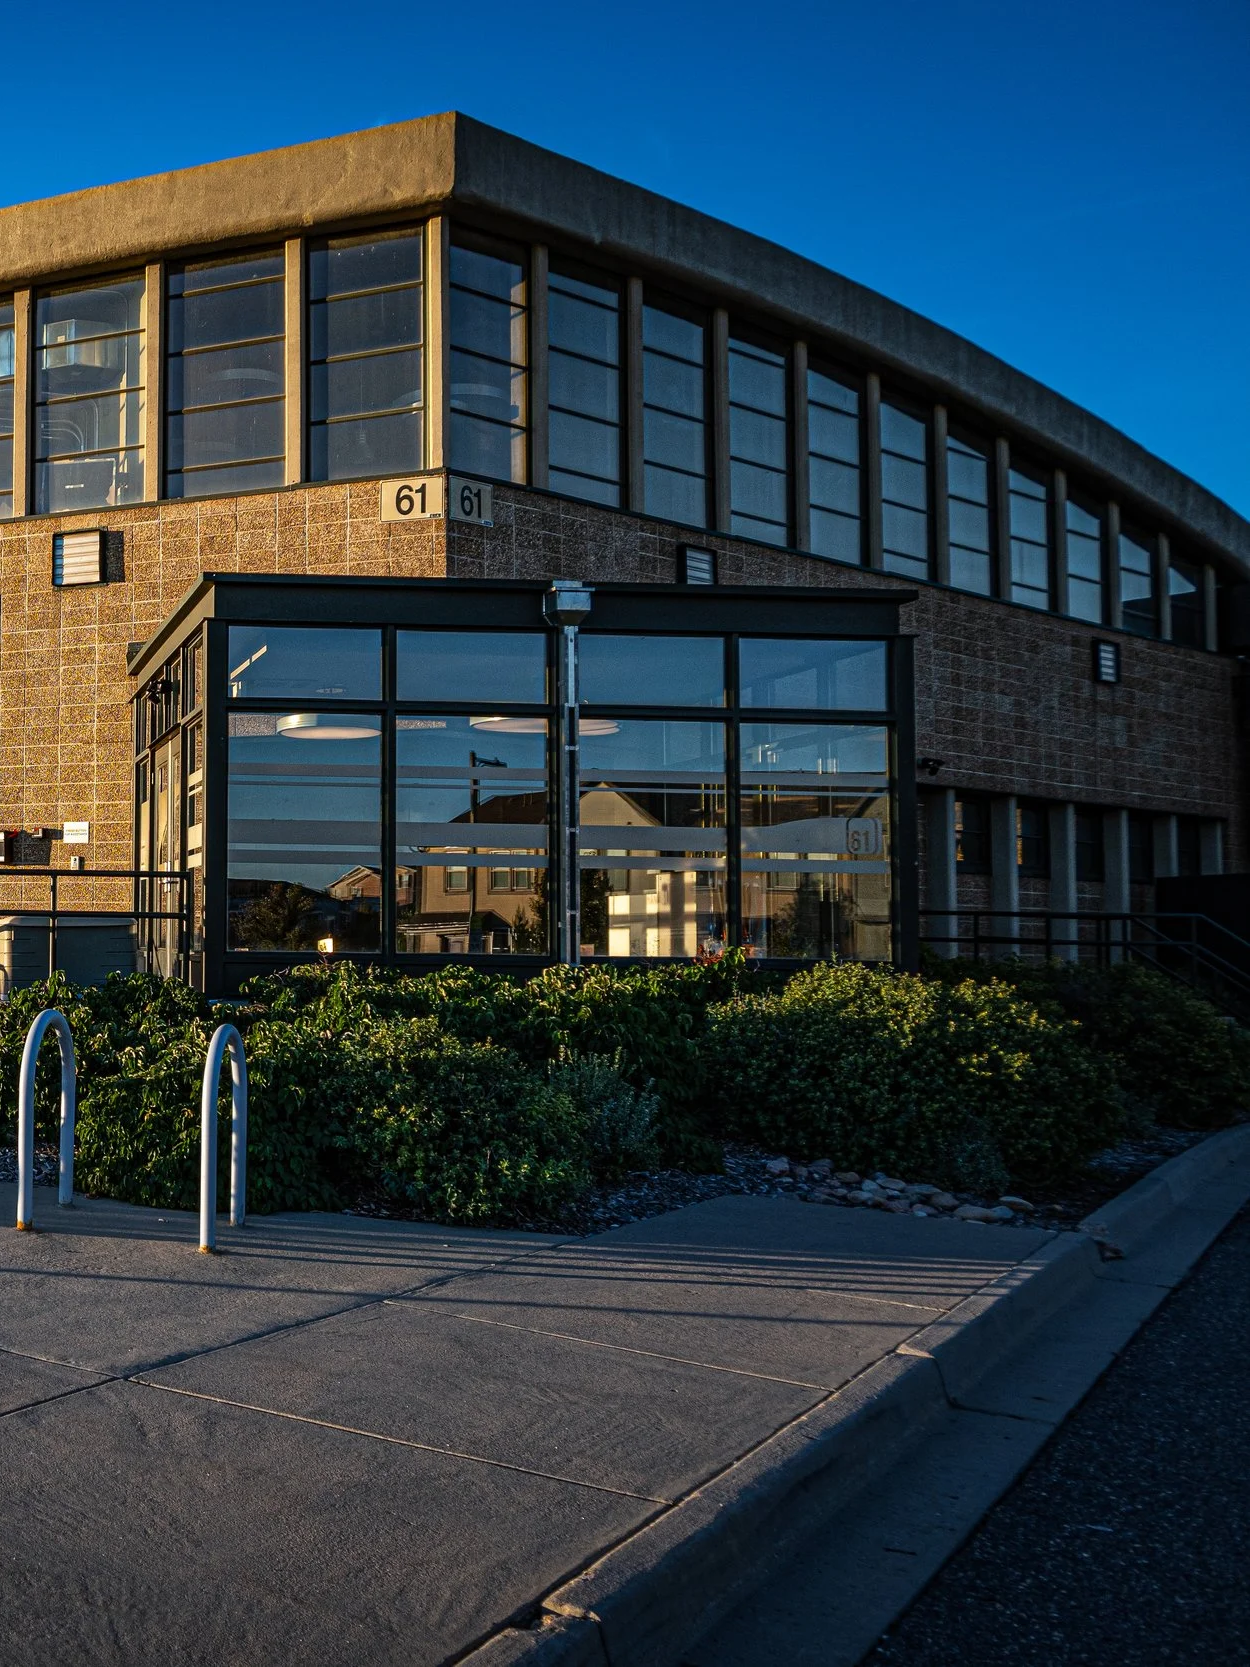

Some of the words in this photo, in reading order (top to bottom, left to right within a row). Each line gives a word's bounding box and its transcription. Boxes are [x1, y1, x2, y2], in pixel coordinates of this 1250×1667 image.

[395, 483, 427, 516] 61
[460, 485, 482, 519] 61
[851, 830, 870, 852] 61
